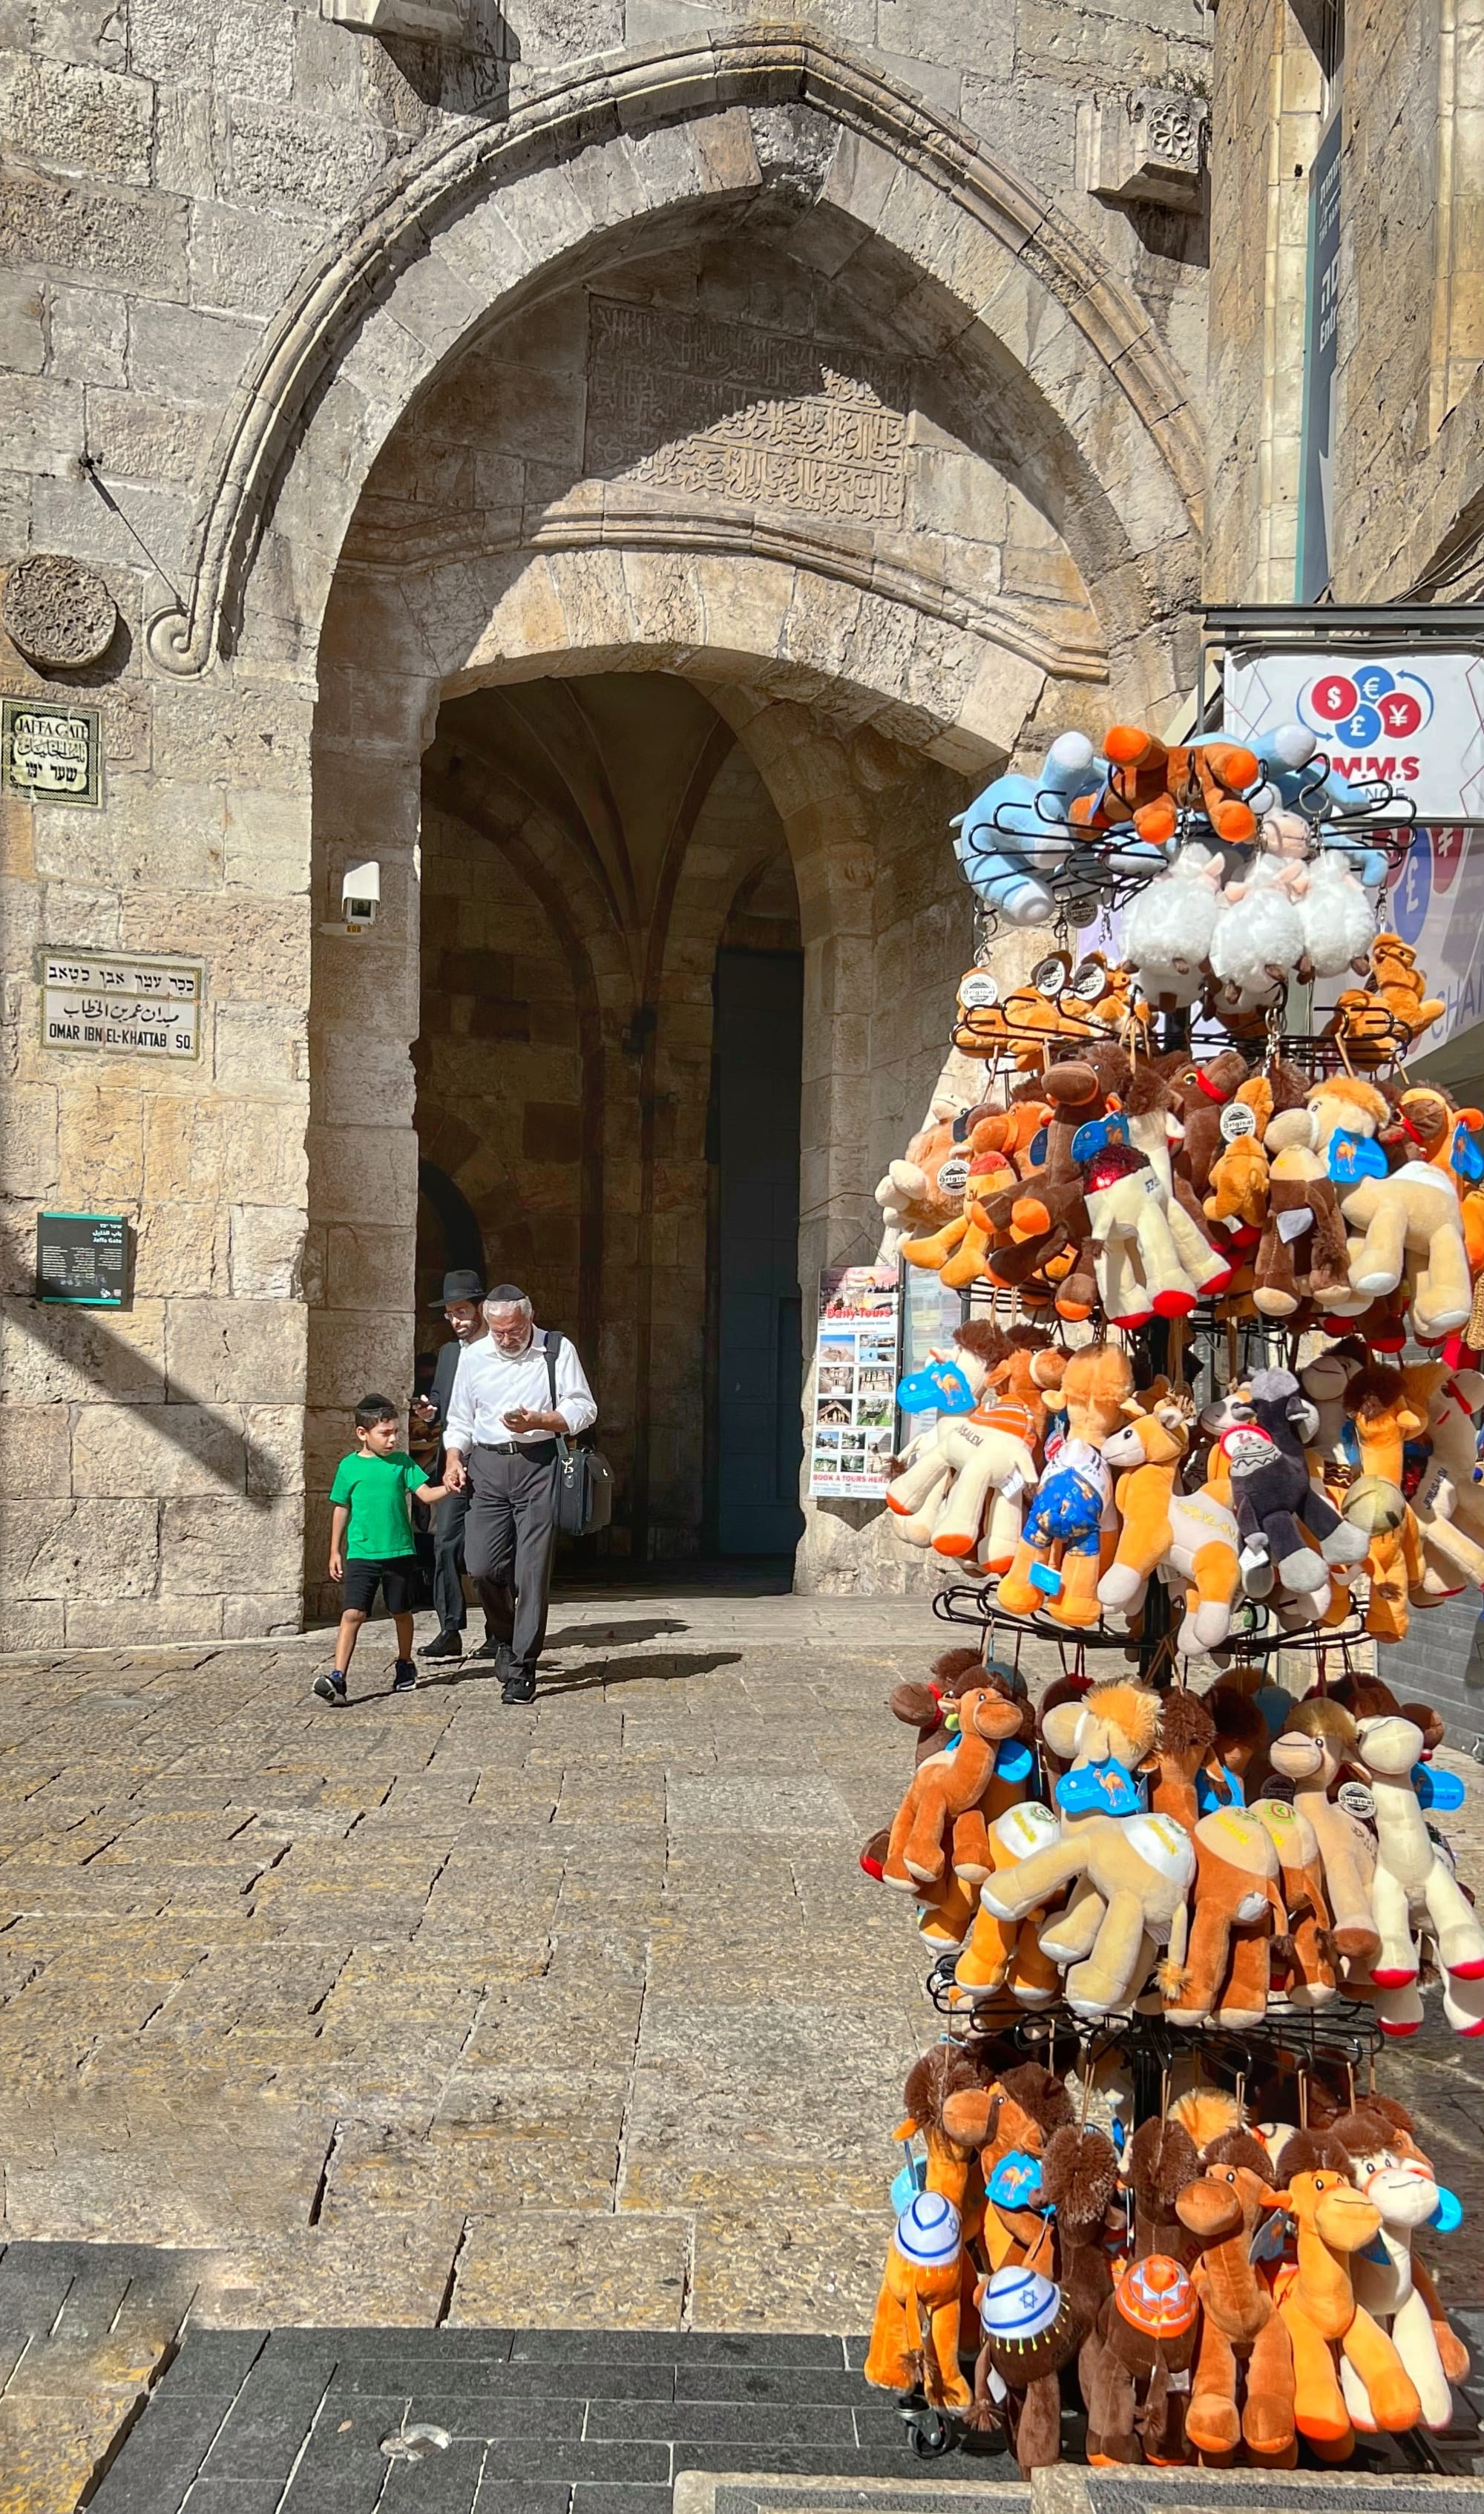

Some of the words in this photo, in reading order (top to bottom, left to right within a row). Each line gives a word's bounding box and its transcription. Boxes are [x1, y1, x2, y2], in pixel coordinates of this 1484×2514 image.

[49, 1023, 80, 1040] OMAR
[84, 1026, 102, 1043] IBN
[106, 1028, 167, 1047] EL-KHATTAB
[176, 1034, 194, 1050] SQ.
[1224, 1119, 1253, 1129] Original
[827, 1307, 856, 1321] Daily
[859, 1307, 891, 1318] Tours
[843, 1475, 867, 1483] TOURS
[1340, 1796, 1375, 1806] Original
